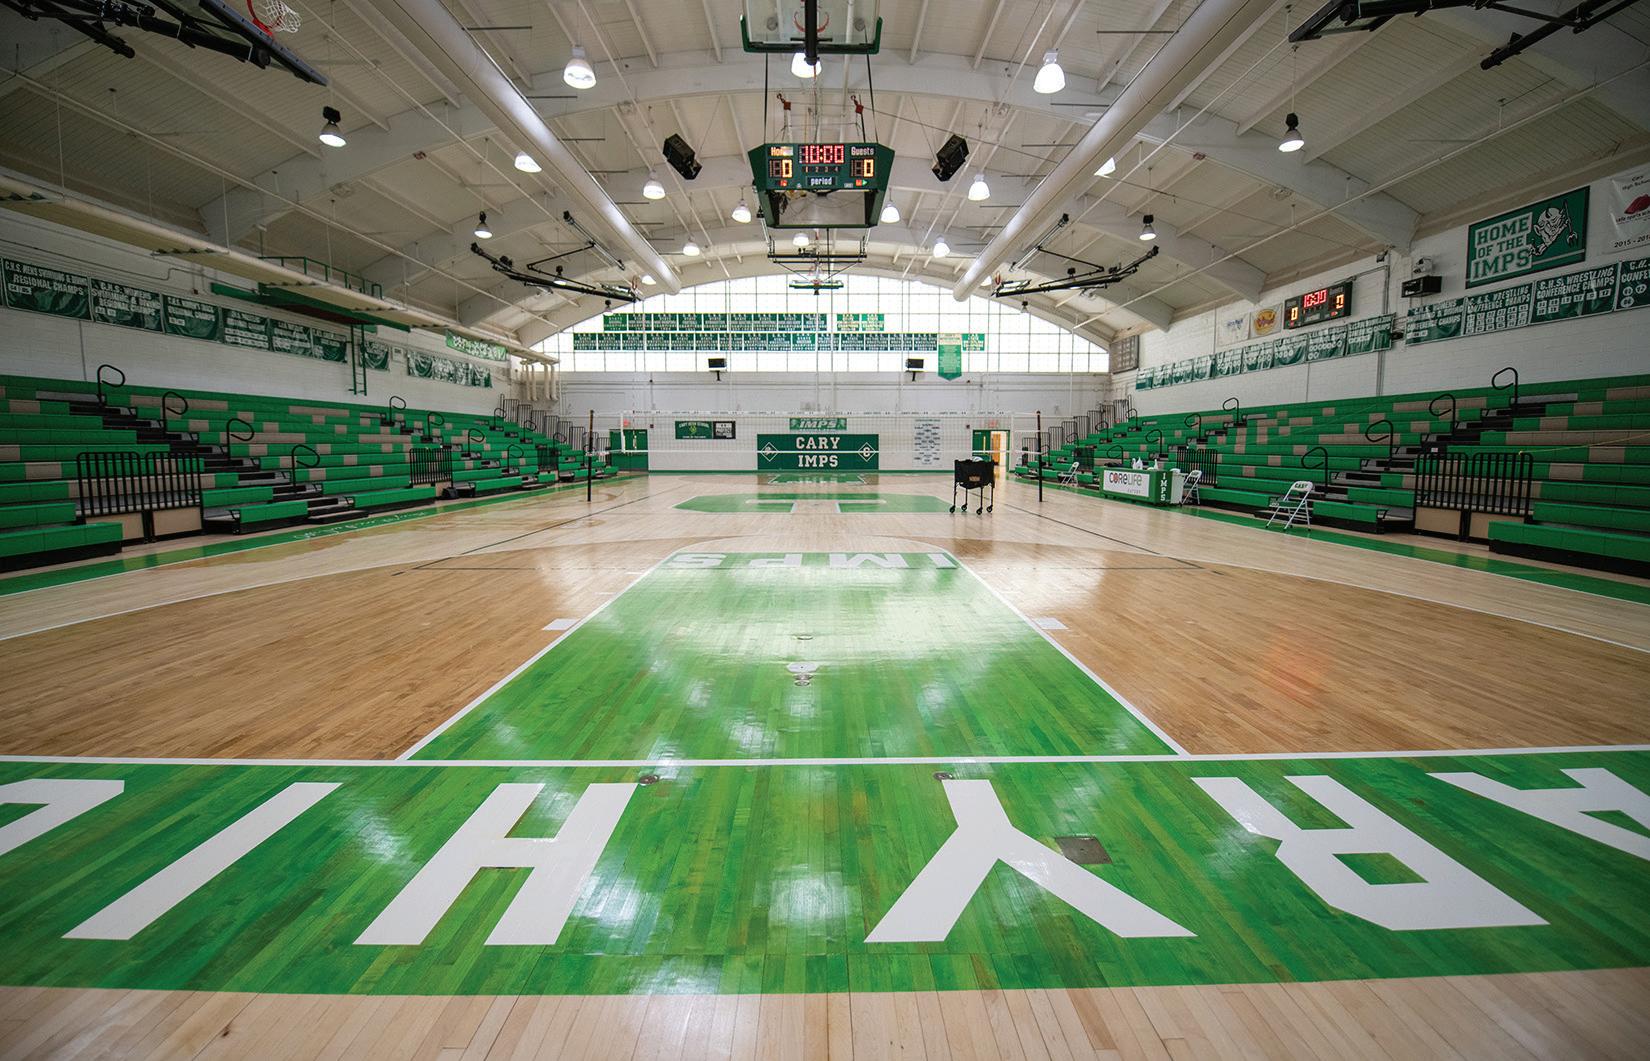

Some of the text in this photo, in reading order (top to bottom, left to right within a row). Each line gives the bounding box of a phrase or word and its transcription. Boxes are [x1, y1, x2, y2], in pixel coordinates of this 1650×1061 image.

[805, 145, 844, 164] 10:00
[851, 146, 874, 155] Guests
[782, 159, 793, 178] 0
[863, 159, 874, 177] 0
[810, 177, 832, 186] period
[1477, 215, 1530, 246] HOME
[1477, 235, 1523, 259] OF THE
[1614, 239, 1631, 248] 2015
[1472, 250, 1531, 280] IMPS
[13, 273, 52, 290] REGIONAL
[53, 281, 84, 296] CHAMPS
[1567, 267, 1614, 284] WRESTLING
[1536, 275, 1615, 300] CONFERENCE CHAMPS
[800, 420, 838, 429] IMPS
[795, 436, 841, 449] CARY
[798, 455, 839, 467] IMPS
[1160, 472, 1169, 502] IMPS
[667, 553, 958, 569] IMPS
